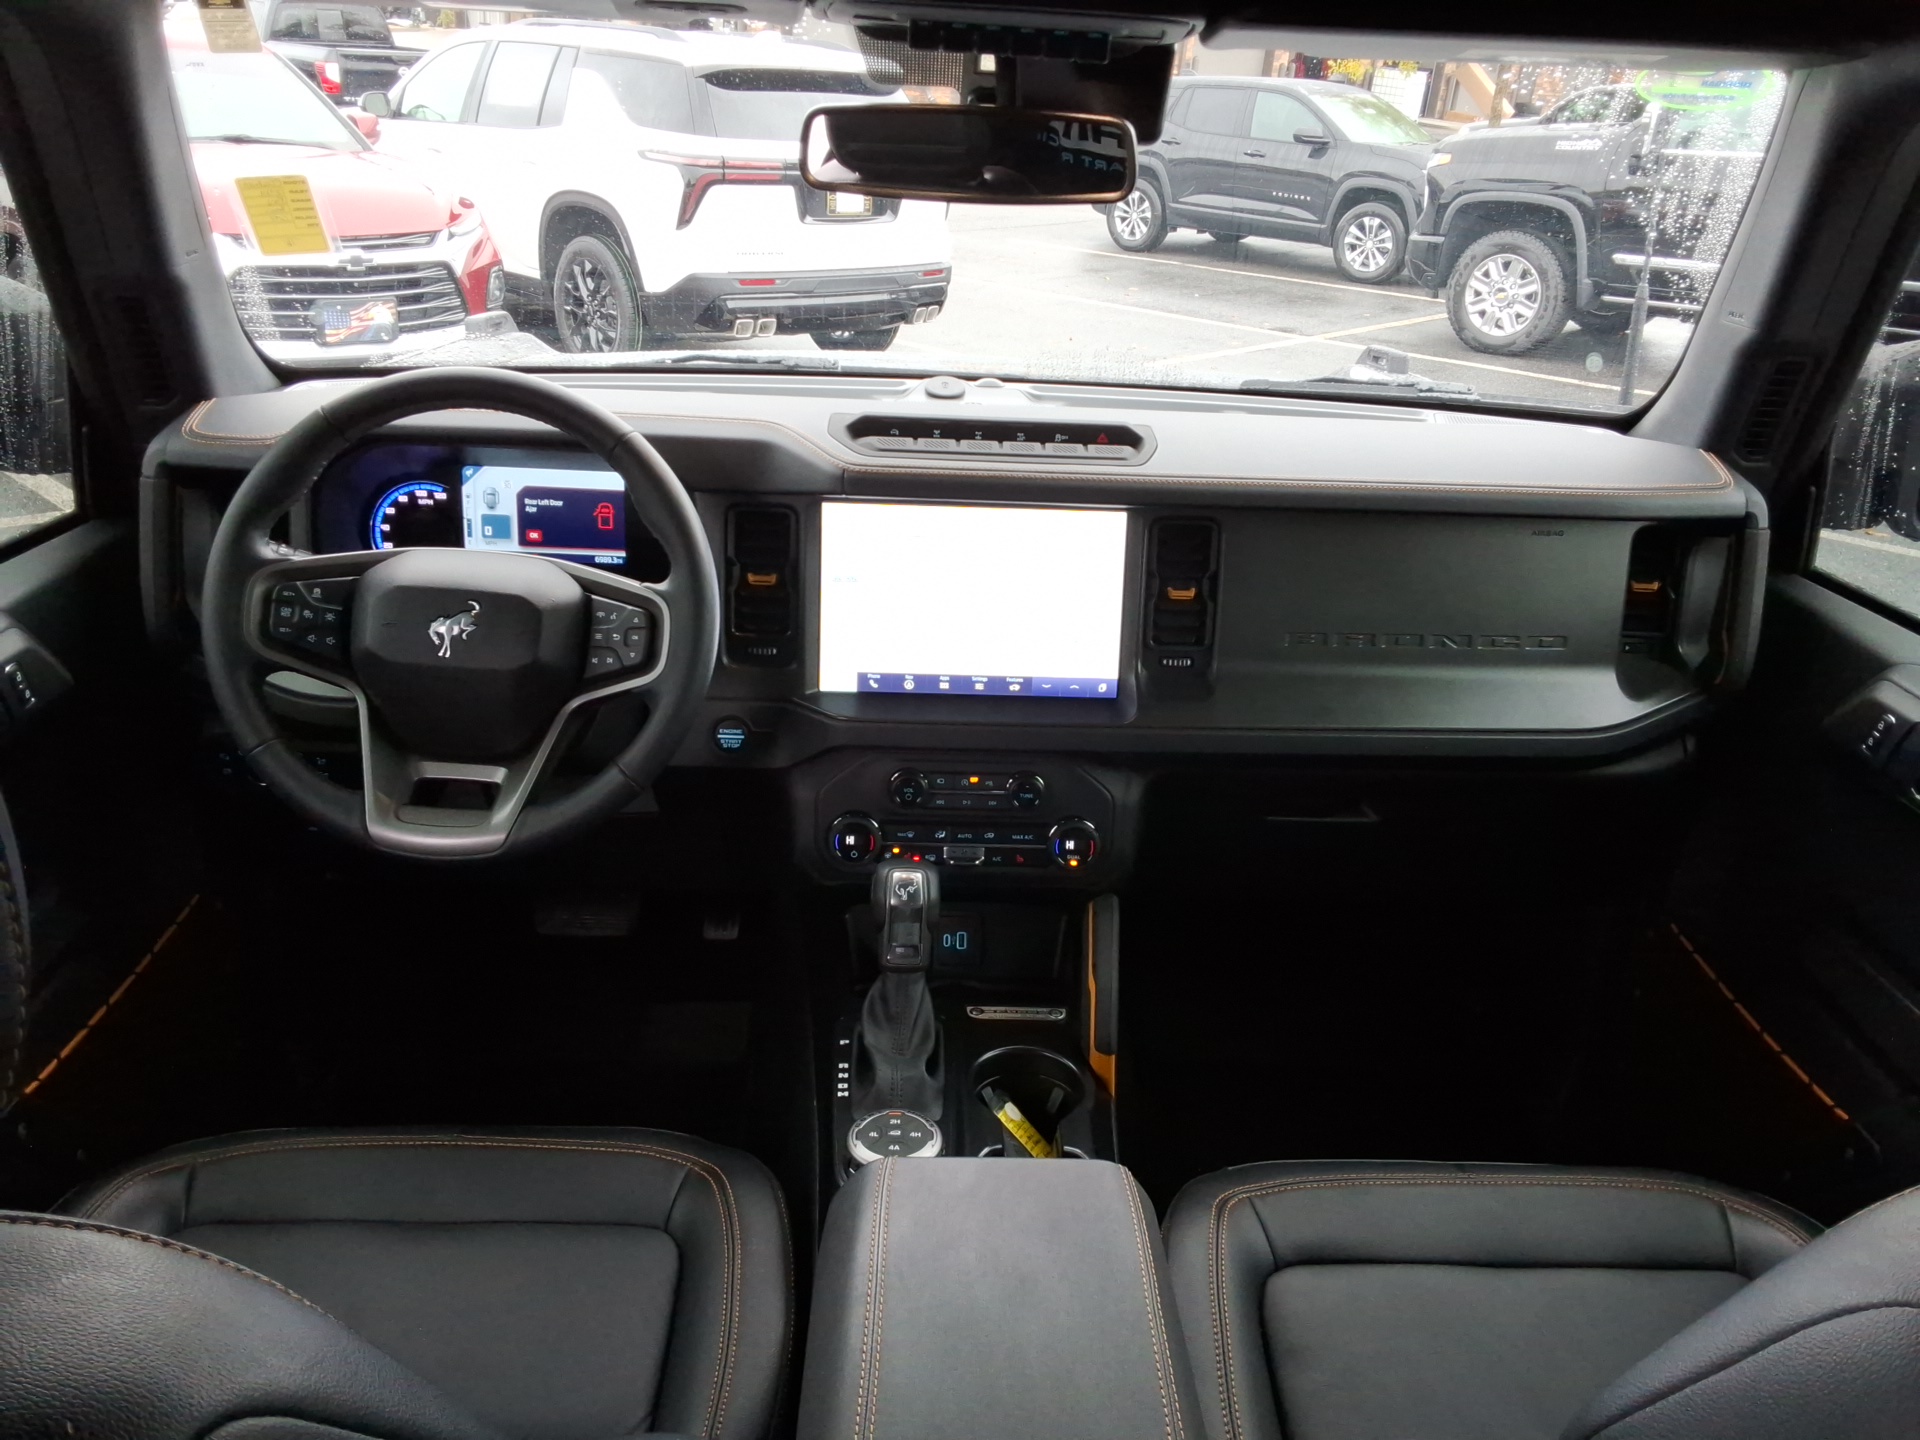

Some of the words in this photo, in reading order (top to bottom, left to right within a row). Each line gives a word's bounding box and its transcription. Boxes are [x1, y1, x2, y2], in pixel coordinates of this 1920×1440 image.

[538, 498, 549, 506] Left
[550, 499, 564, 507] Door
[525, 505, 537, 513] Ajar
[1283, 631, 1568, 650] BRONCO
[845, 835, 855, 846] HI
[1066, 840, 1075, 851] HI
